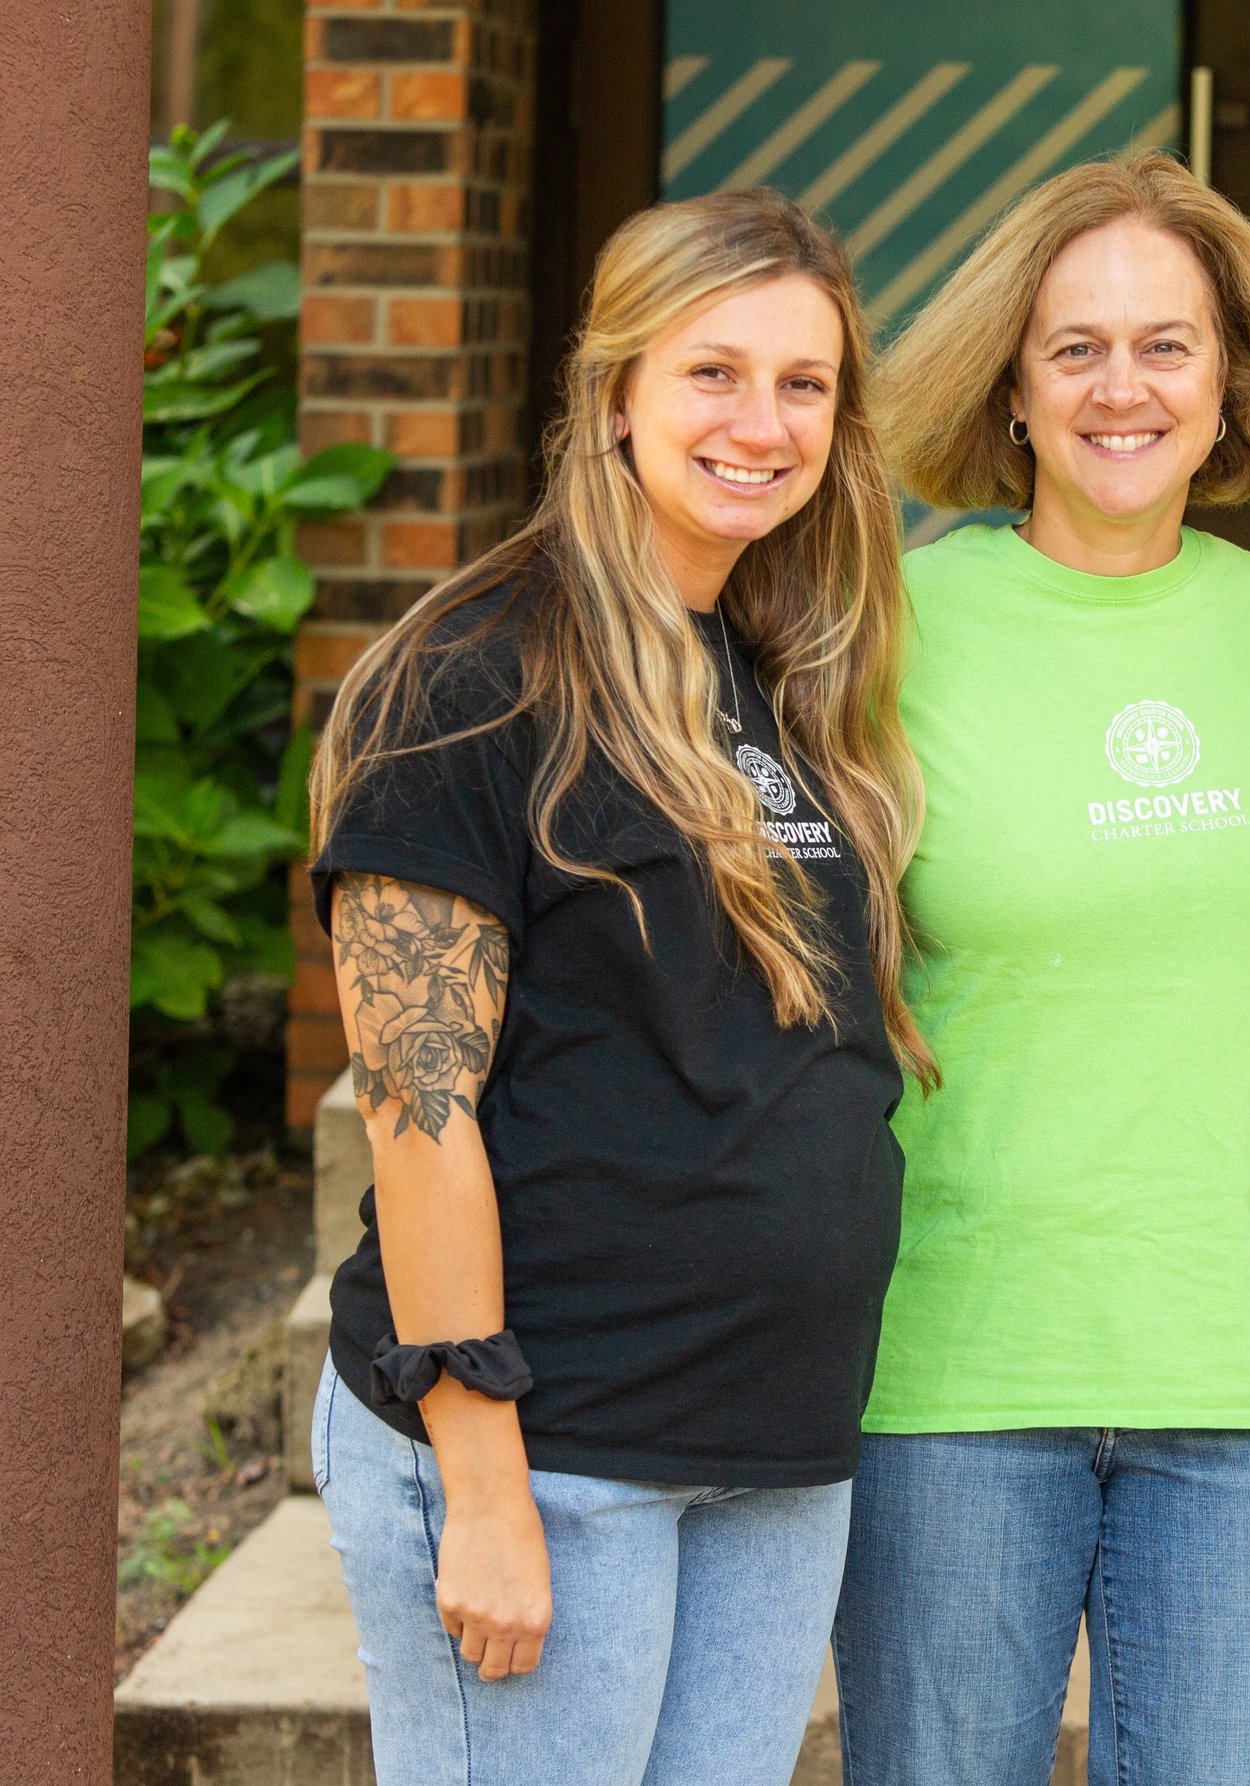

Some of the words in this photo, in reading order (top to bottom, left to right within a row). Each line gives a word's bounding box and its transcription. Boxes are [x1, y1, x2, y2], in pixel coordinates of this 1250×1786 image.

[1088, 787, 1241, 826] DISCOVERY
[1091, 823, 1176, 841] CHARTER
[802, 847, 841, 859] SCHOOL
